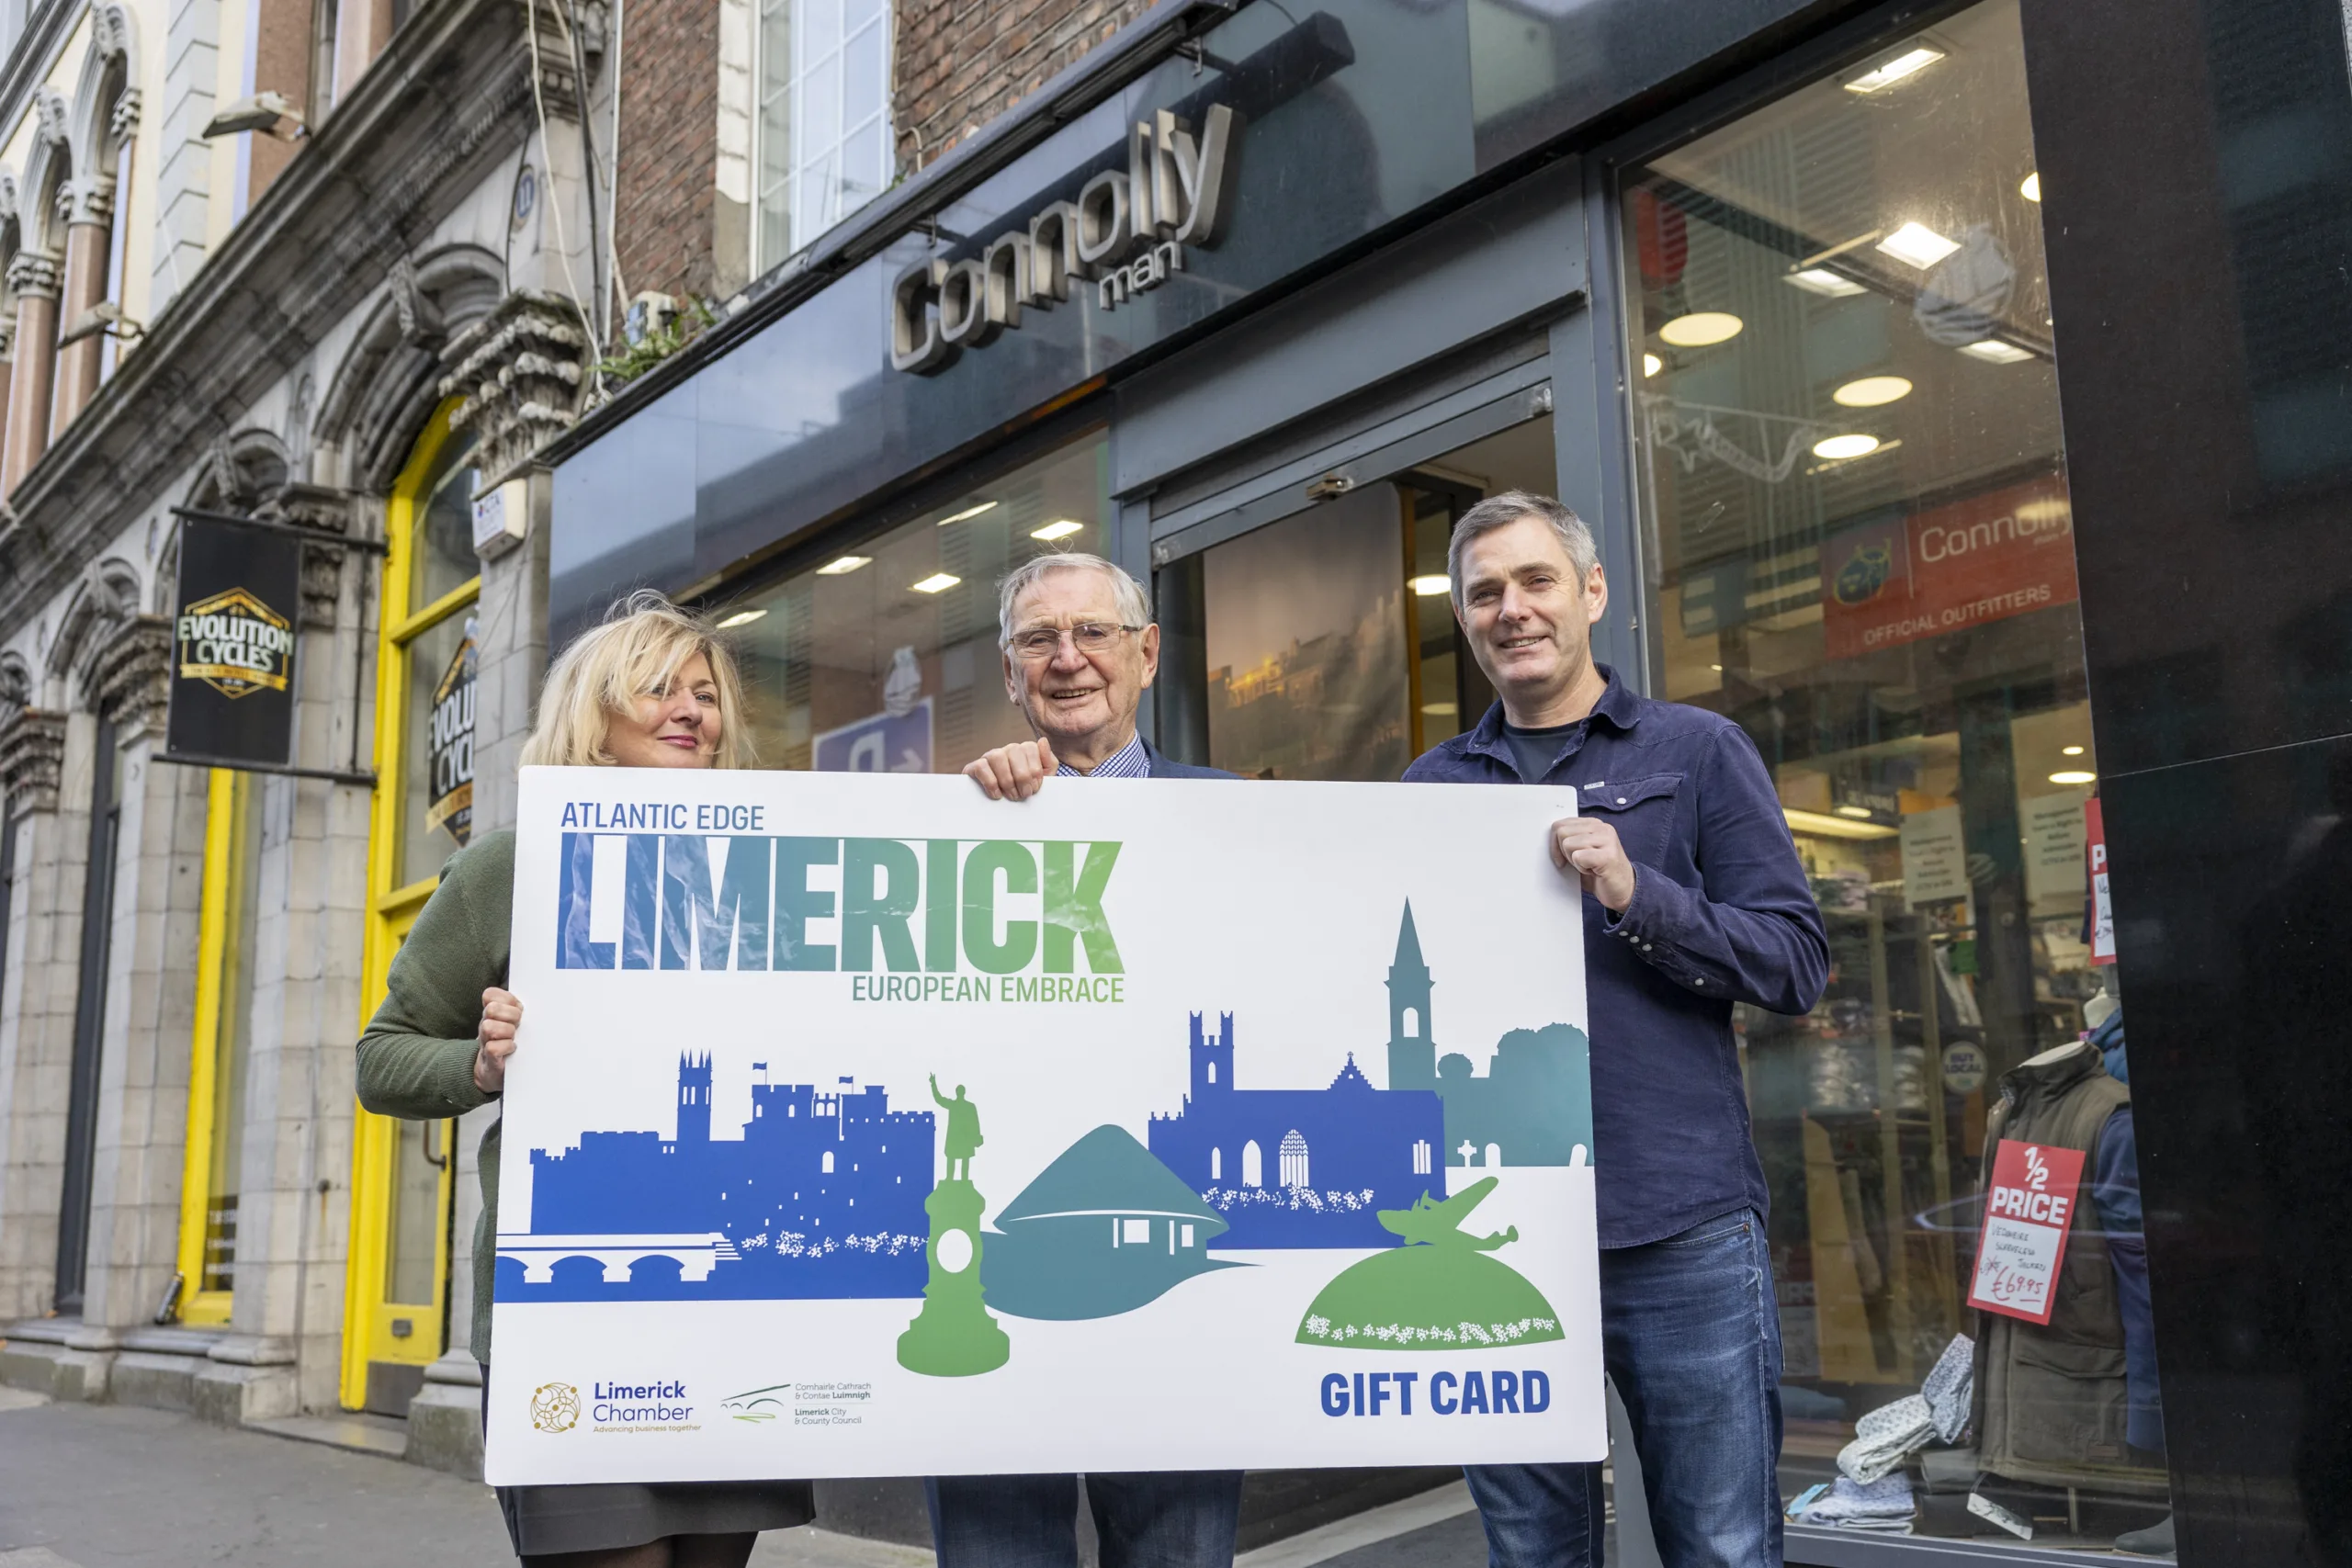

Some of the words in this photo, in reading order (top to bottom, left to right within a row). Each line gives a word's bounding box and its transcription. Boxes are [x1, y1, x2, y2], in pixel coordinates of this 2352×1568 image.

[890, 102, 1232, 371] Connolly
[1099, 241, 1183, 310] man
[1864, 614, 1938, 645] OFFICIAL
[1941, 584, 2052, 626] OUTFITTERS
[177, 615, 294, 656] EVOLUTION
[196, 639, 274, 672] CYCLES
[560, 802, 688, 829] ATLANTIC
[696, 805, 764, 830] EDGE
[555, 832, 1125, 975] LIMERICK
[852, 976, 991, 1002] EUROPEAN
[1001, 976, 1125, 1003] EMBRACE
[1990, 1186, 2069, 1225] PRICE
[1991, 1266, 2044, 1301] €69.95
[594, 1381, 686, 1399] Limerick
[795, 1382, 835, 1391] Comhairle
[837, 1382, 872, 1391] Cathrach
[832, 1391, 871, 1401] Luimnigh
[1320, 1371, 1419, 1416] GIFT
[1430, 1370, 1551, 1416] CARD
[593, 1403, 694, 1422] Chamber
[795, 1408, 830, 1416] Limerick
[831, 1407, 847, 1417] City
[802, 1417, 831, 1427] County
[832, 1416, 862, 1425] Council
[593, 1426, 634, 1434] Advancing
[636, 1425, 667, 1433] business
[669, 1424, 702, 1434] together
